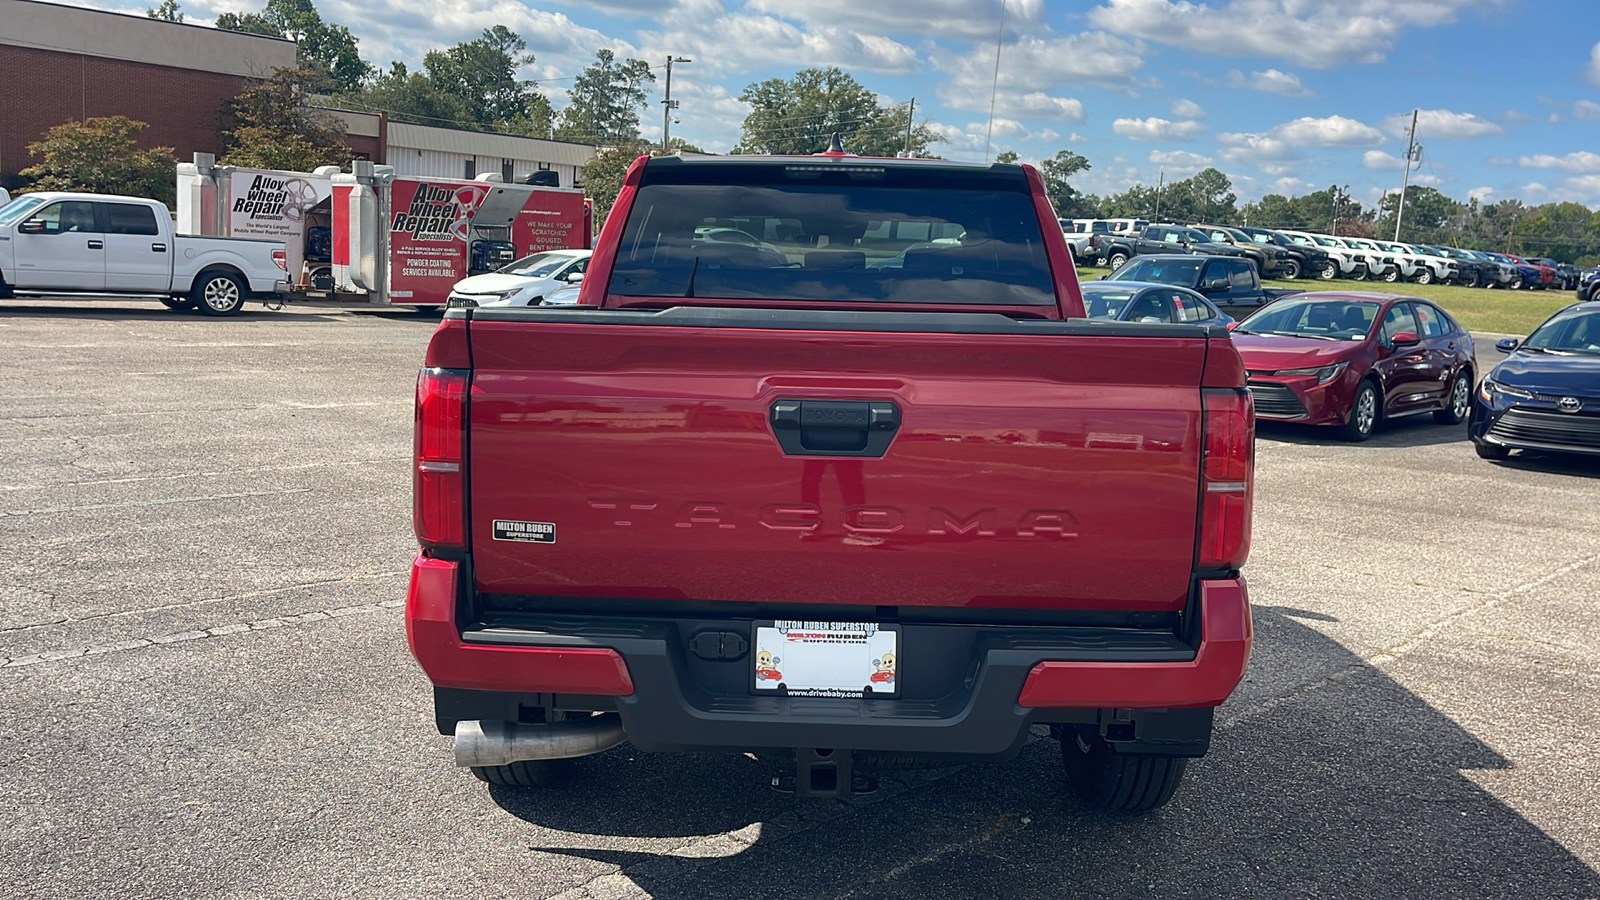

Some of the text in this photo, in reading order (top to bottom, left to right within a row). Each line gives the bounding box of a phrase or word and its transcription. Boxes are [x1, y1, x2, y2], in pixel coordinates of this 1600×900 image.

[250, 175, 284, 191] Alloy
[412, 183, 455, 203] Alloy
[233, 198, 284, 219] Repair
[409, 202, 459, 218] wheel
[392, 213, 455, 239] Repair
[406, 258, 451, 268] POWDER COATING
[402, 268, 455, 277] SERVICES AVAILABLE
[804, 409, 866, 422] TOYOTA
[587, 498, 1080, 537] TACOMA
[496, 521, 553, 534] MILTON RUBEN
[506, 531, 544, 539] SUPERSTORE
[774, 620, 880, 632] MILTON RUBEN SUPERSTORE
[787, 689, 863, 699] www.drivebaby.com
